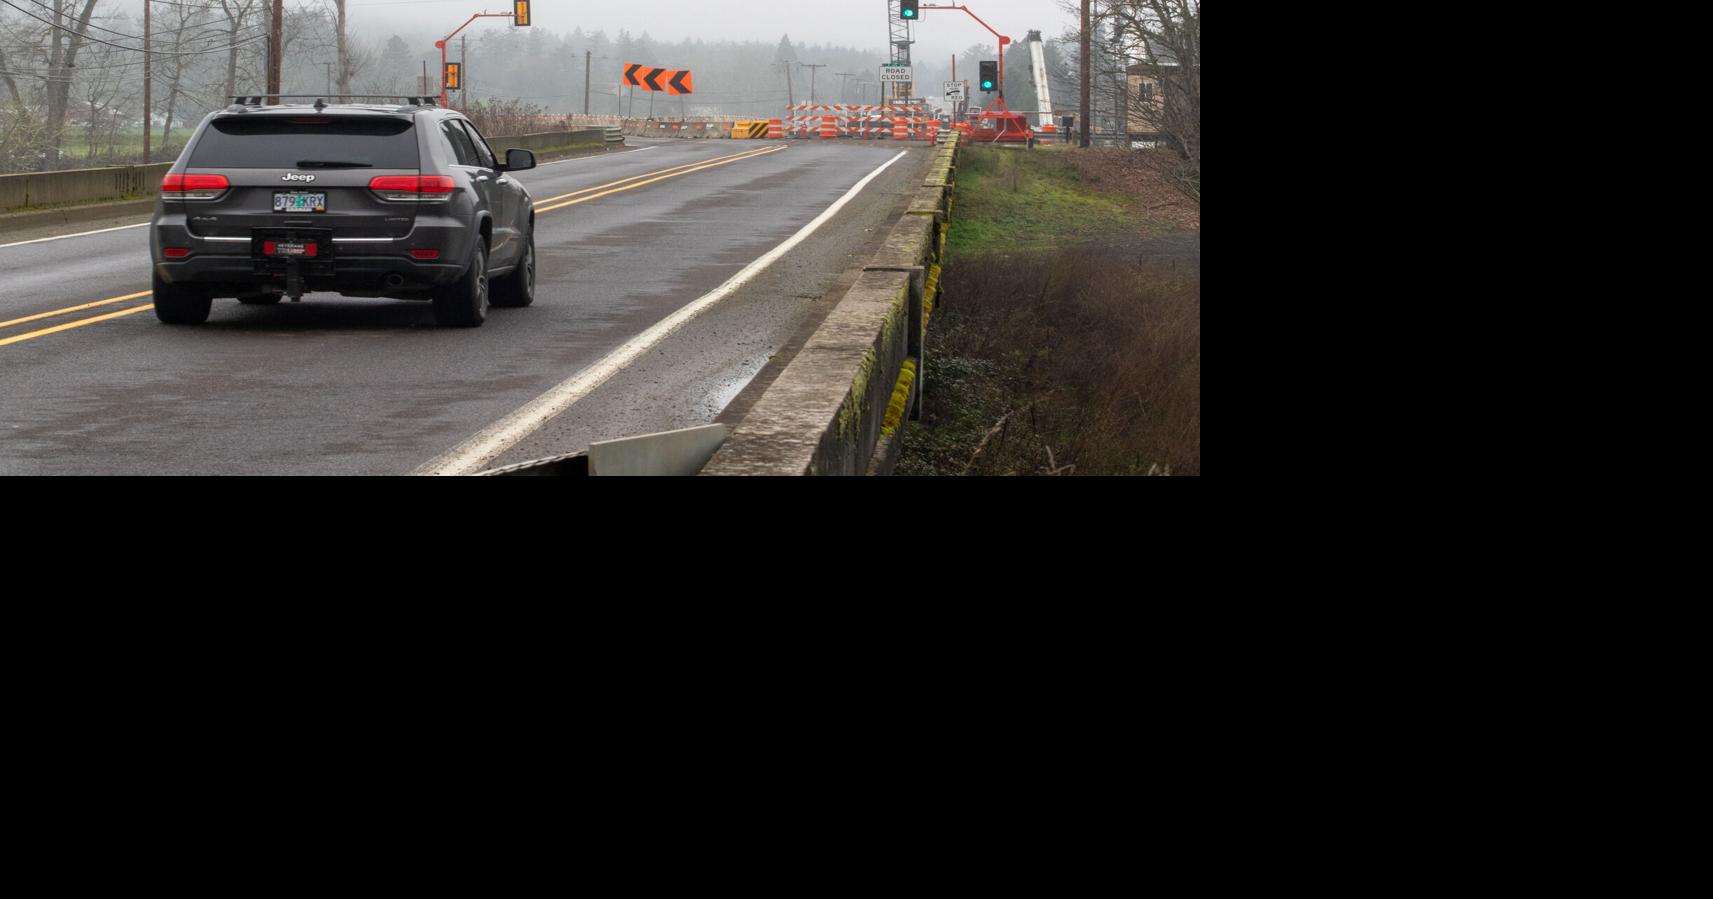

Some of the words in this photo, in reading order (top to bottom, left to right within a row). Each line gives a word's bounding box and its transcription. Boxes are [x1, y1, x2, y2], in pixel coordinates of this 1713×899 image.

[282, 173, 315, 182] Jeep
[274, 196, 296, 207] 879
[304, 195, 324, 207] KRX
